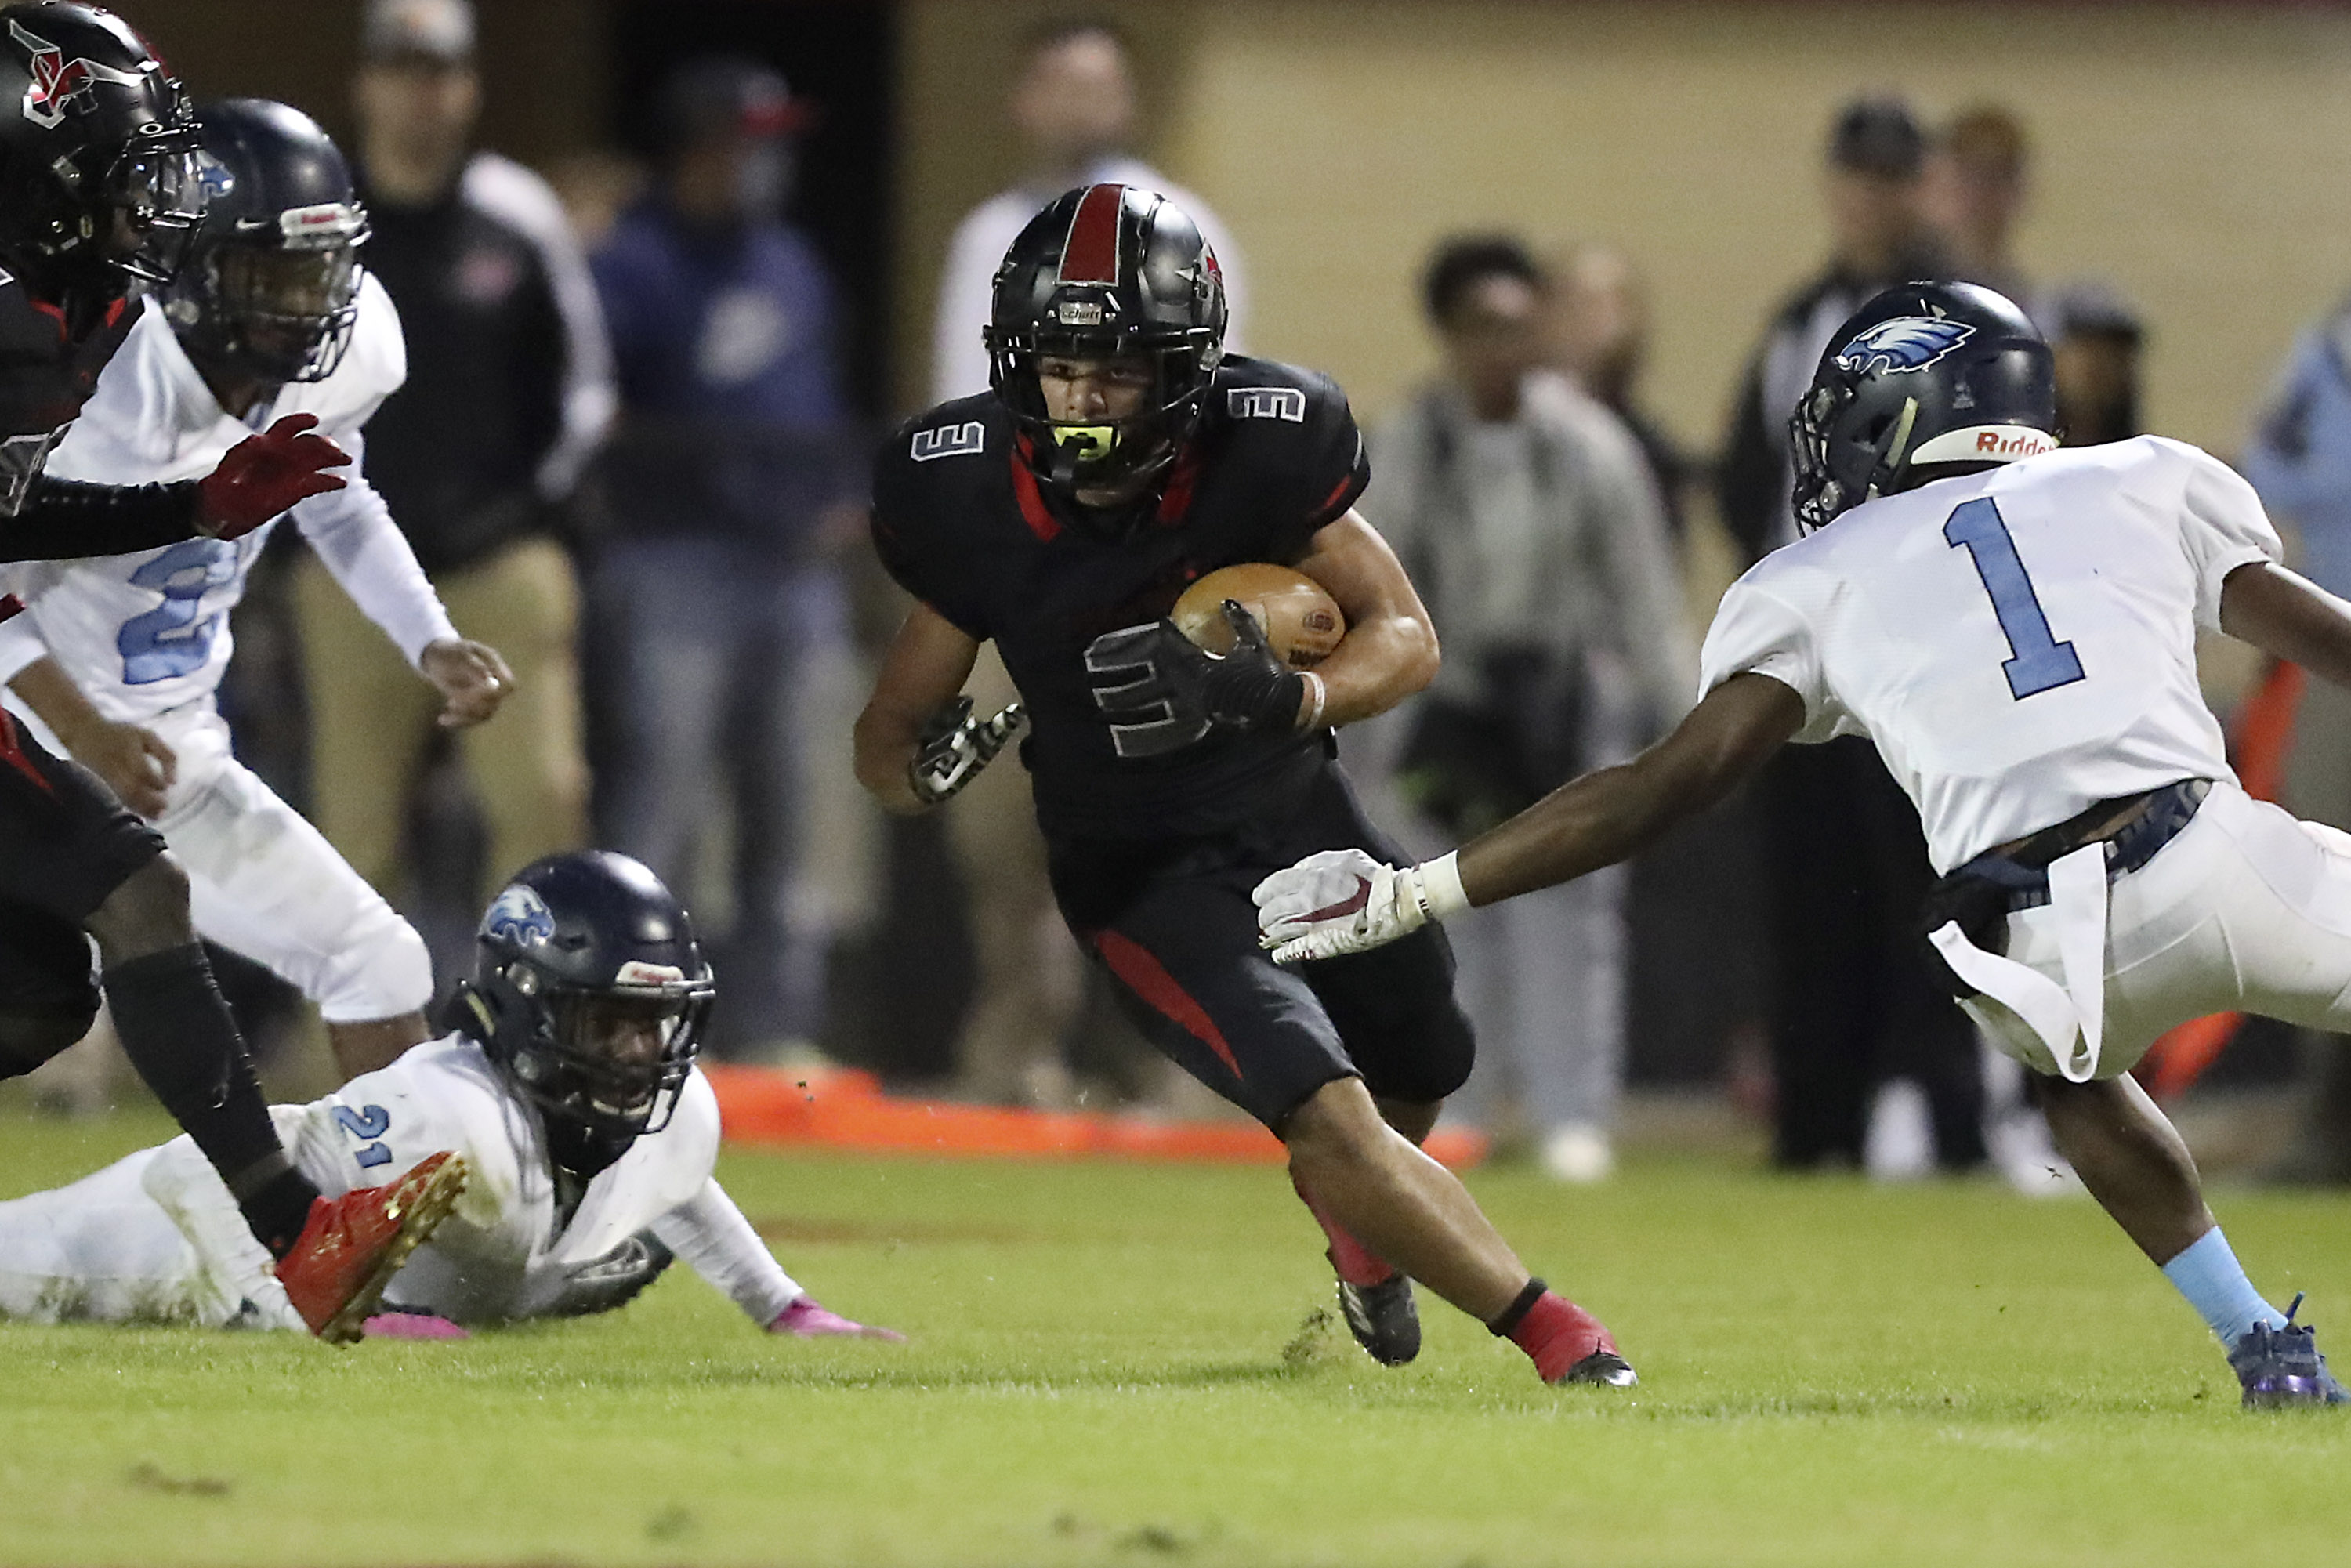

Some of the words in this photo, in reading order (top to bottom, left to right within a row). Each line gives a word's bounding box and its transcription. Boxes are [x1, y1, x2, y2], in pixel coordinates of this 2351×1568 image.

[911, 421, 985, 462] 3
[1227, 387, 1306, 422] 3
[117, 538, 238, 685] 2
[1943, 496, 2086, 701] 1
[1083, 621, 1213, 758] 3
[331, 1104, 393, 1168] 21
